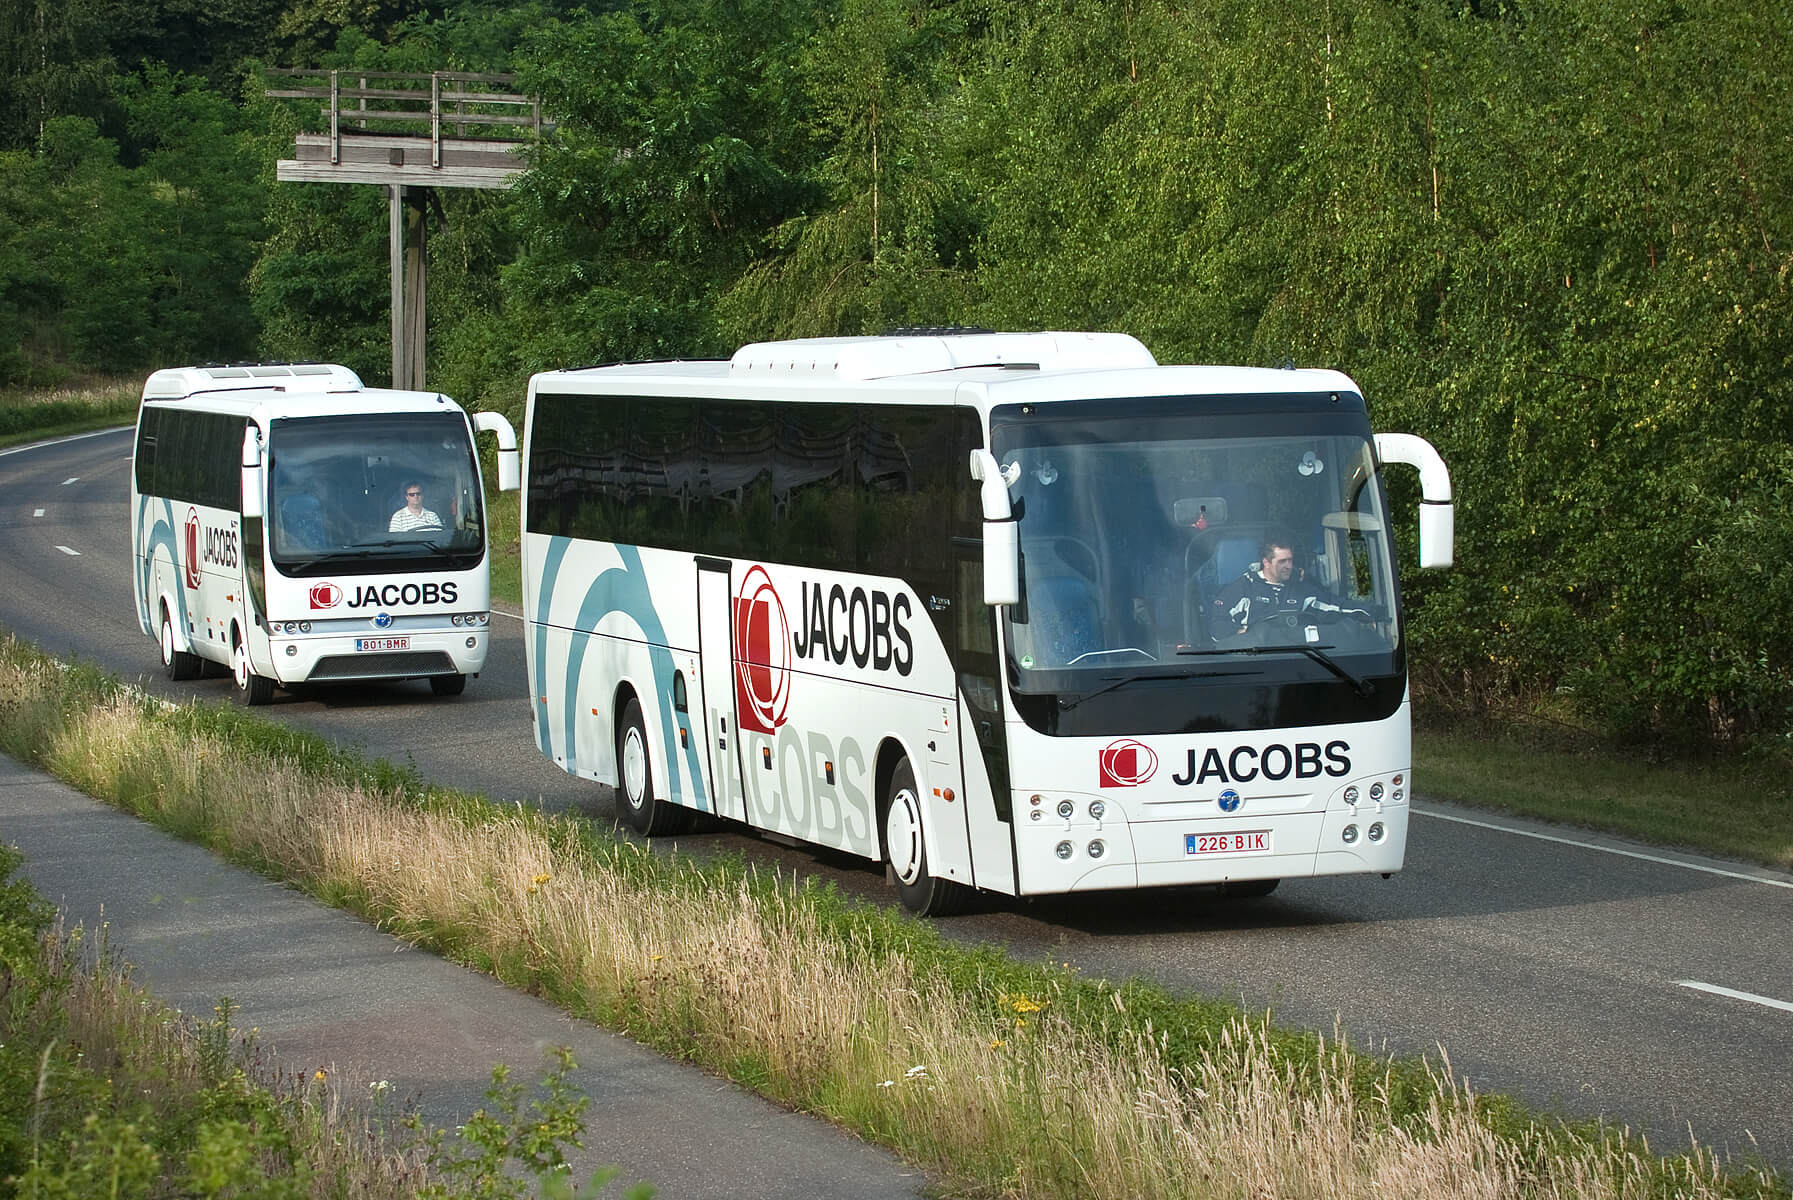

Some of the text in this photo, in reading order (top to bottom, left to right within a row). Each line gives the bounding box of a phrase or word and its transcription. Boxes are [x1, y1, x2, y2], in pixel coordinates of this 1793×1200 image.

[204, 526, 237, 568] JACOBS
[348, 582, 458, 608] JACOBS
[794, 581, 913, 676] JACOBS
[707, 708, 872, 856] JACOBS
[1172, 740, 1351, 786] JACOBS
